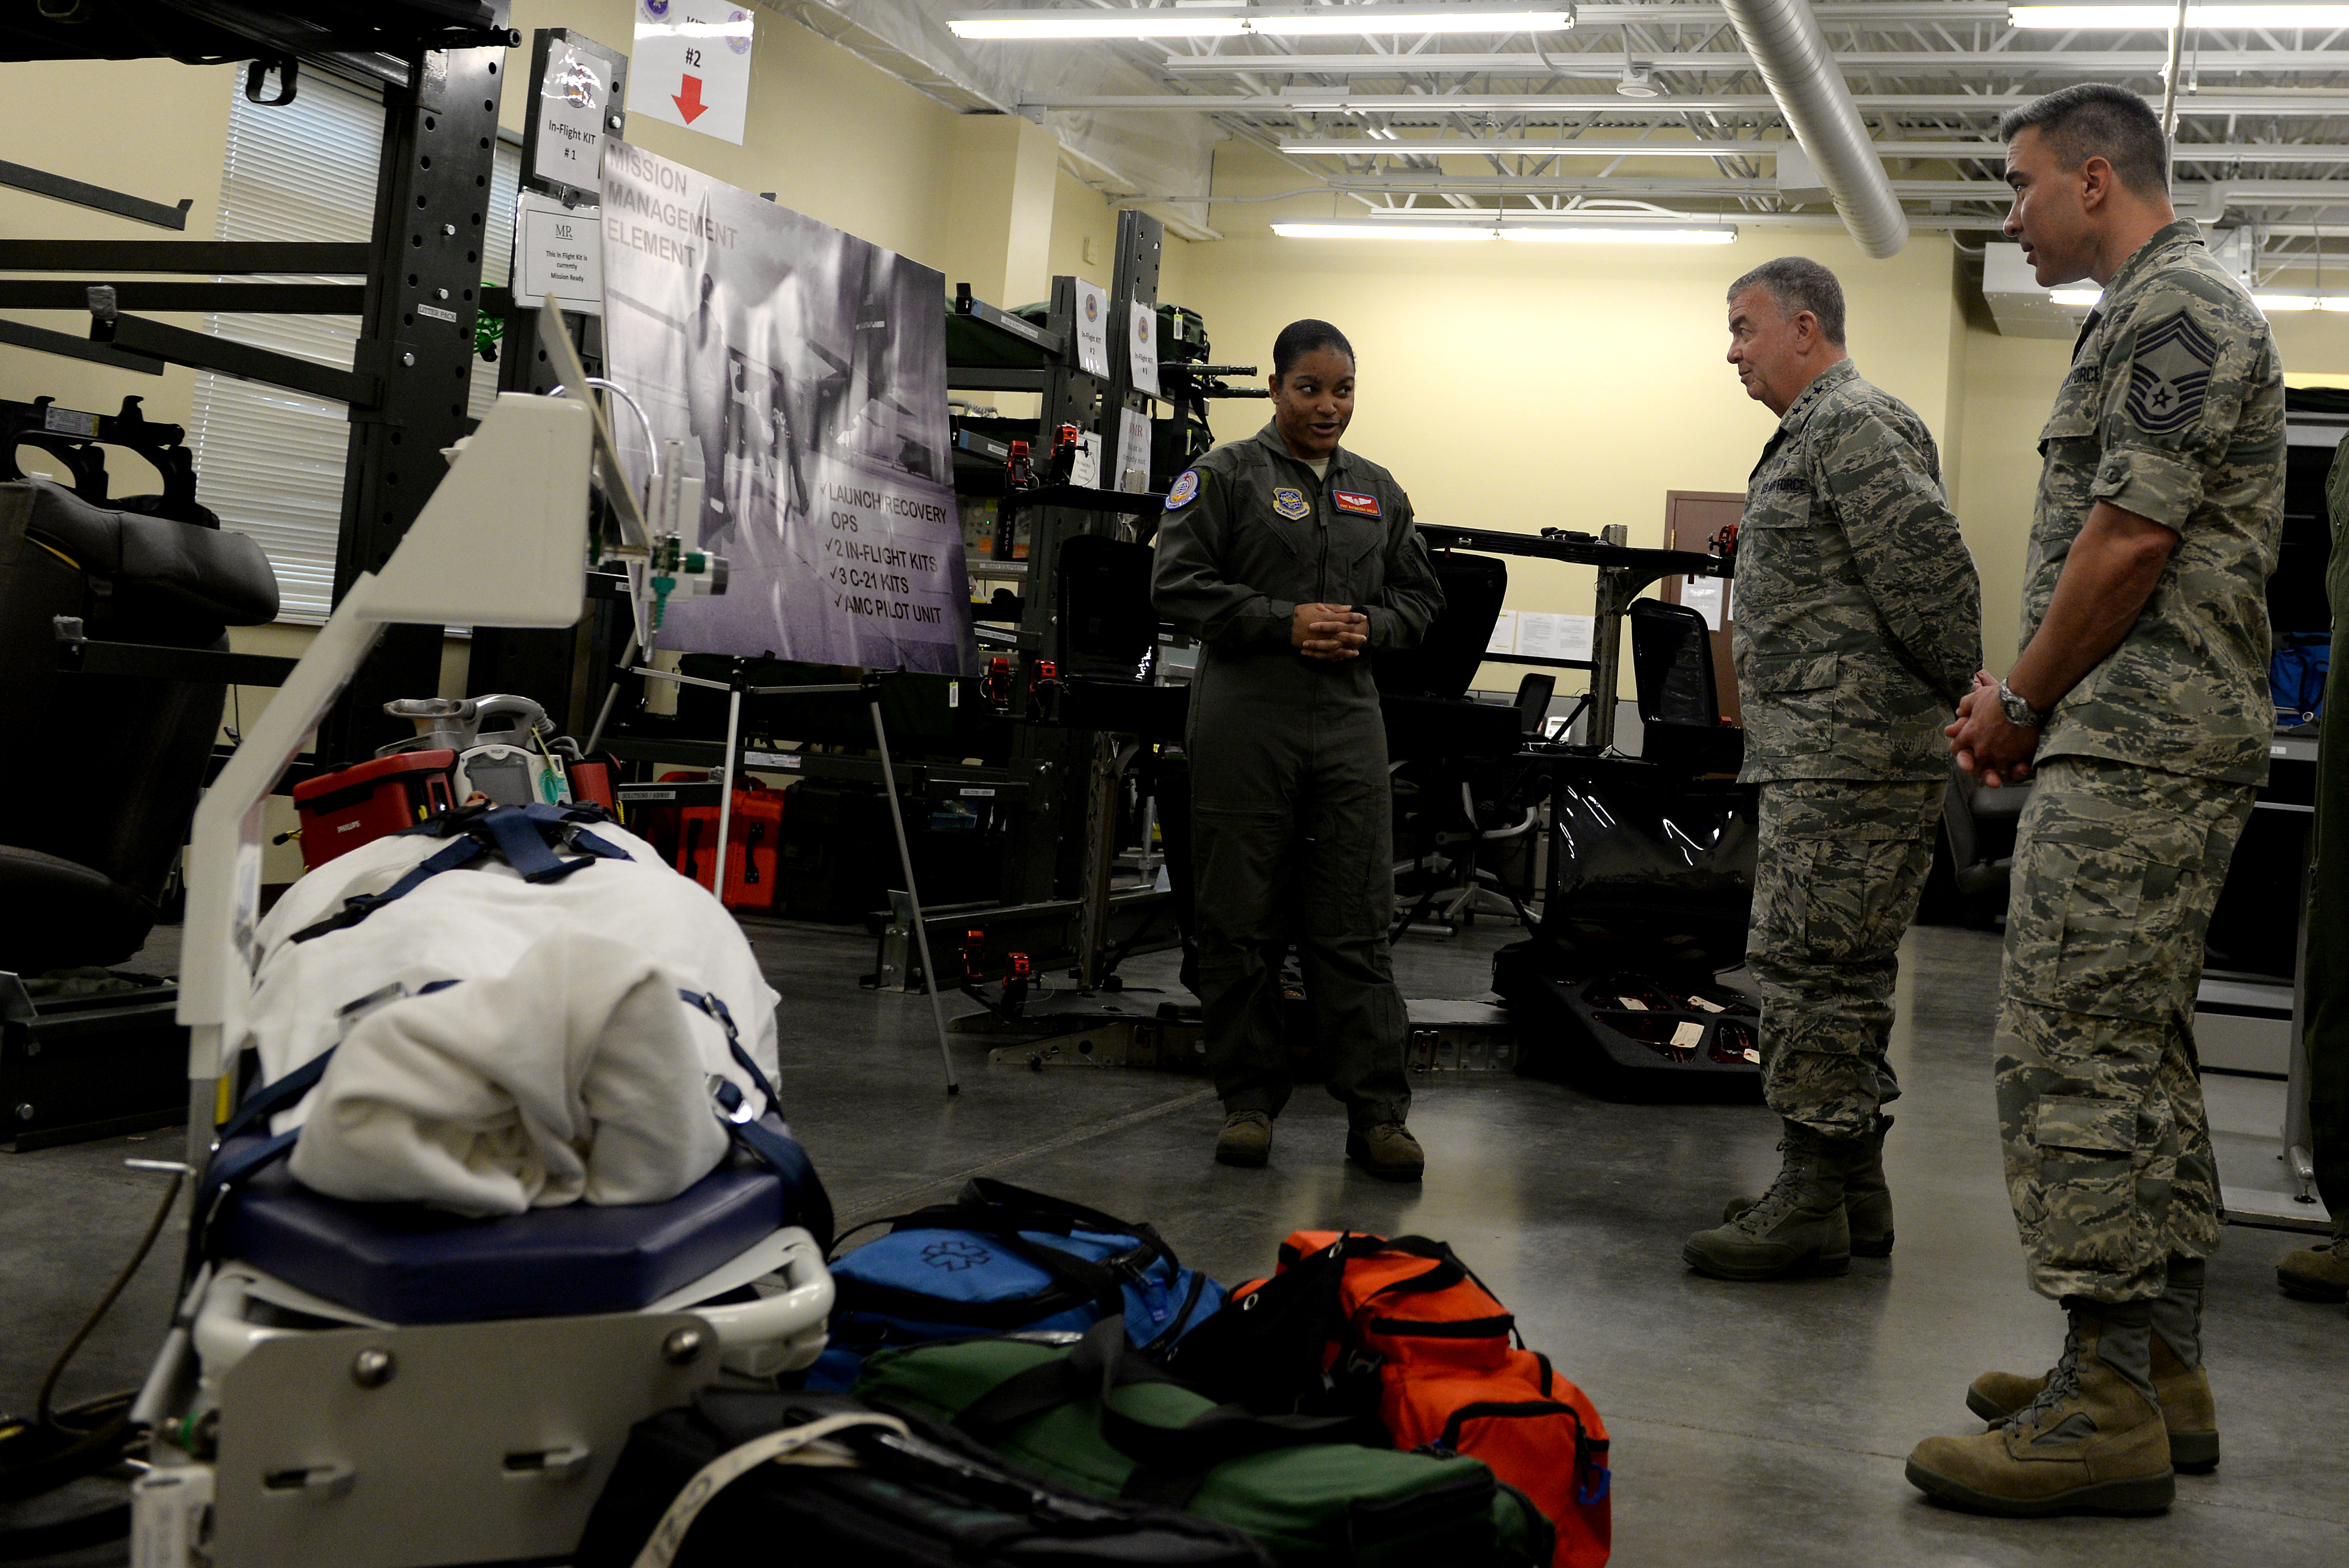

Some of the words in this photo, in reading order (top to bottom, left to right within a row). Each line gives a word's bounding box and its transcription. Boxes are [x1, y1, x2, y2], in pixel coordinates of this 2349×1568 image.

[685, 47, 701, 68] #2
[548, 120, 581, 141] In-Flight
[583, 132, 596, 145] KIT
[610, 144, 687, 197] MISSION
[607, 181, 737, 249] MANAGEMENT
[556, 224, 573, 237] MR
[607, 217, 695, 268] ELEMENT
[556, 262, 577, 270] currently
[562, 252, 575, 261] Flight
[551, 272, 569, 281] Mission
[569, 274, 584, 283] Ready
[2070, 366, 2100, 384] FORCE
[1776, 479, 1806, 491] FORCE
[831, 511, 858, 533] OPS
[834, 539, 843, 557] 2
[845, 541, 906, 568] IN-FLIGHT
[909, 552, 938, 573] KITS
[839, 567, 847, 585] 3
[850, 569, 877, 590] C-21
[880, 573, 909, 594] KITS
[845, 595, 873, 616] AMC
[875, 599, 909, 620] PILOT
[912, 605, 941, 624] UNIT
